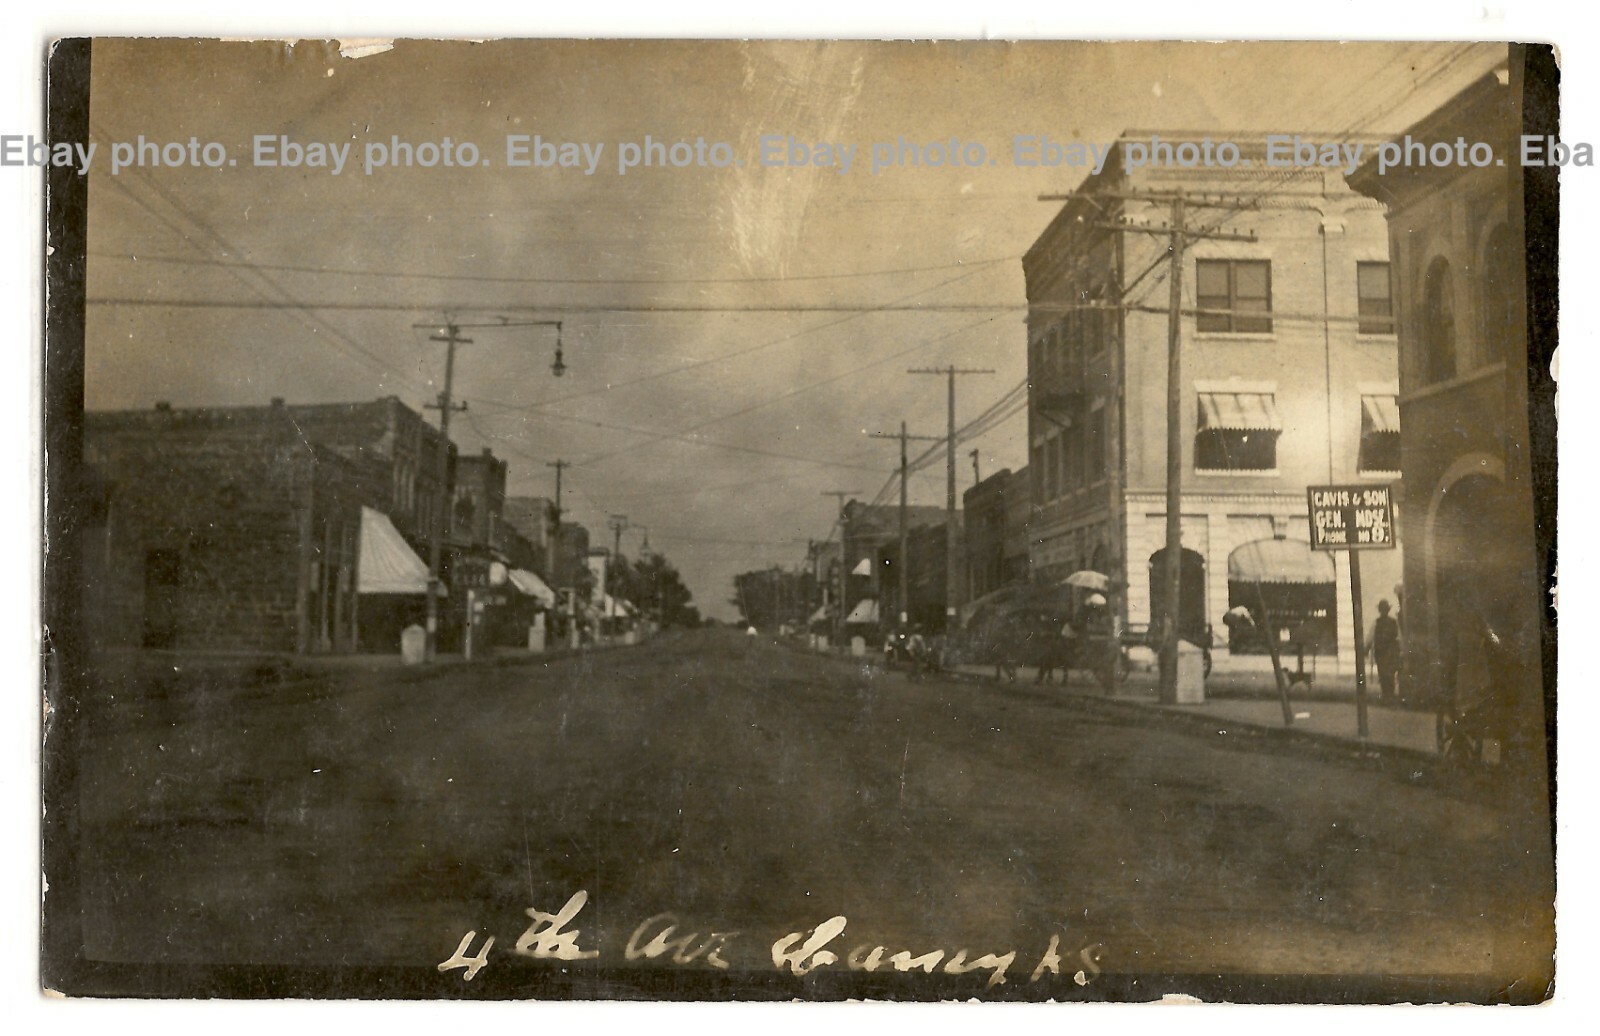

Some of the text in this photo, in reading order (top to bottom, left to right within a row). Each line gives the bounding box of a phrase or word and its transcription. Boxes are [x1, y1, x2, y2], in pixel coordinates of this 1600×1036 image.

[1314, 491, 1349, 507] CAVIS
[1363, 490, 1386, 506] SON
[1316, 510, 1346, 528] GEN.
